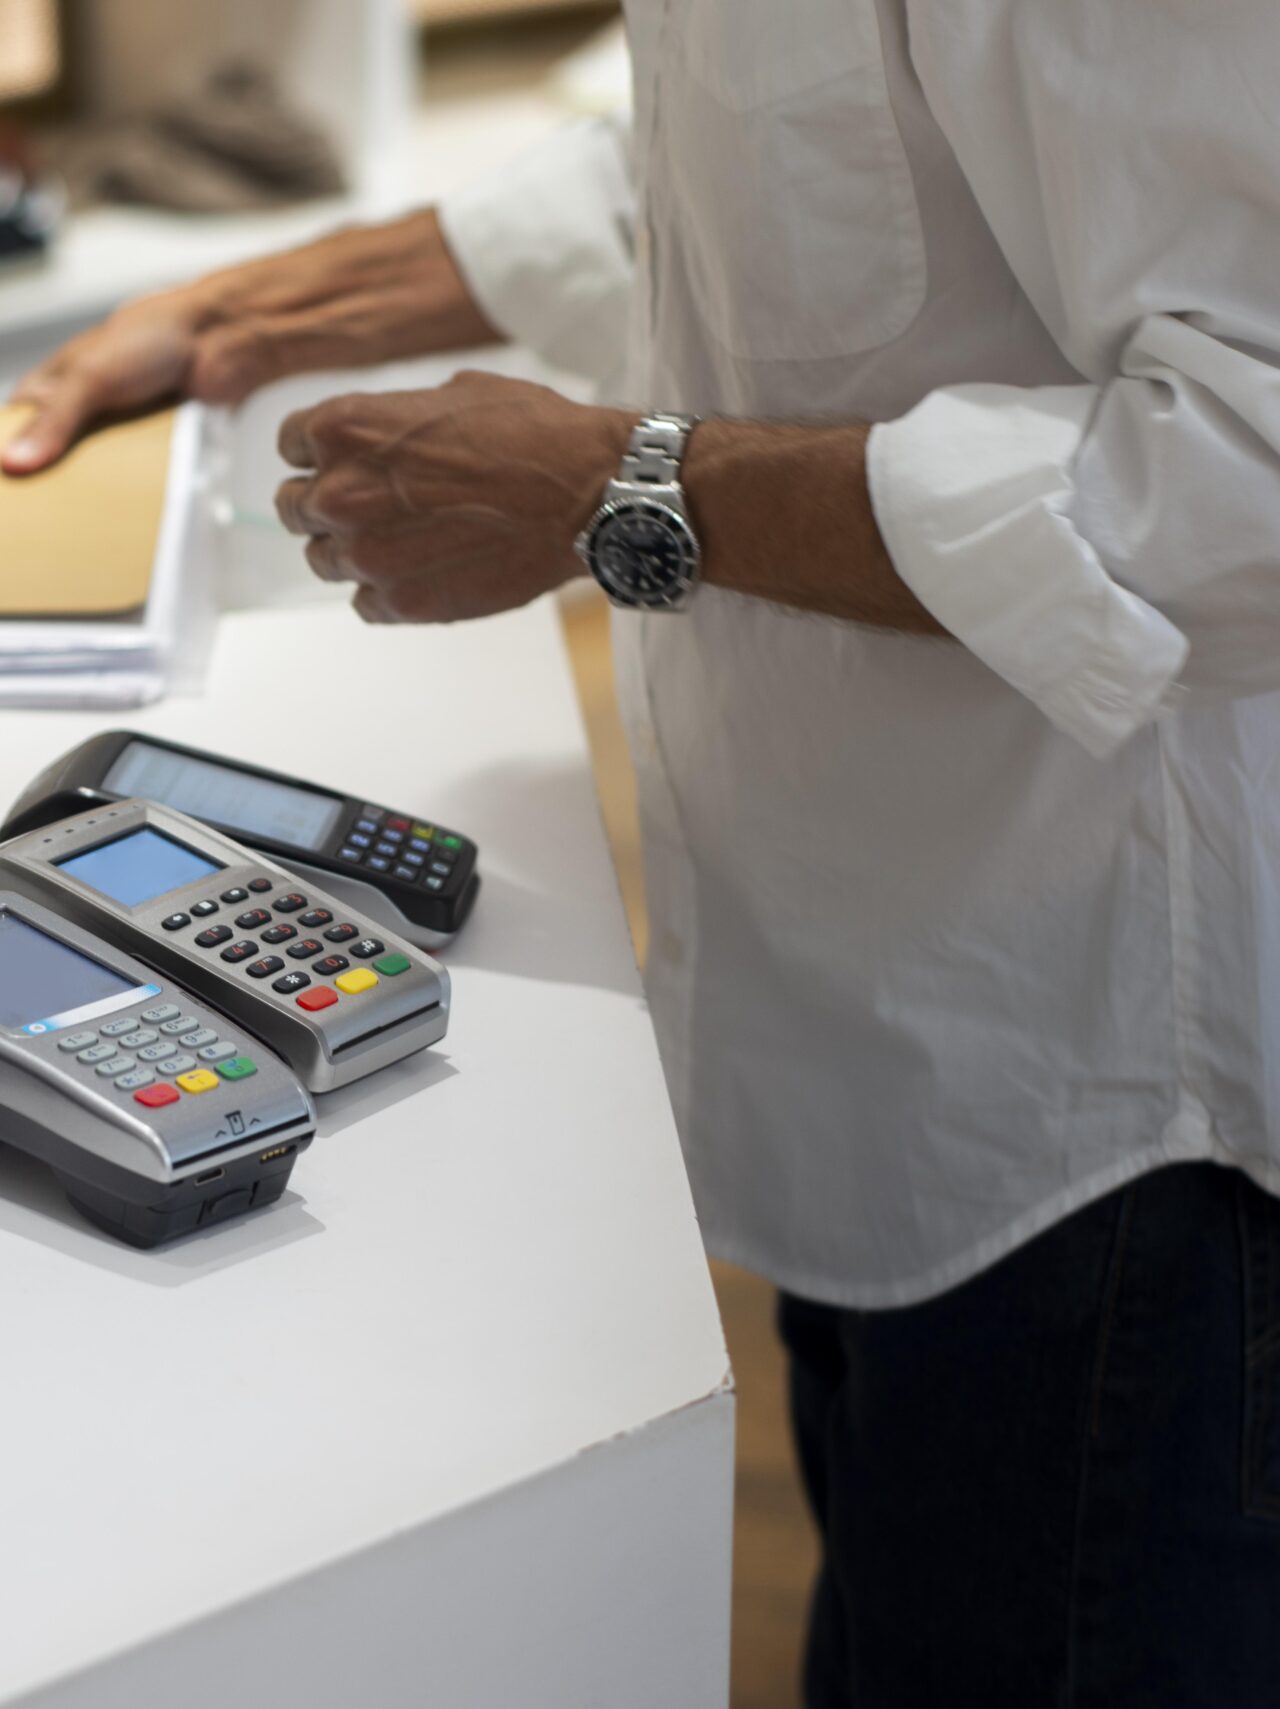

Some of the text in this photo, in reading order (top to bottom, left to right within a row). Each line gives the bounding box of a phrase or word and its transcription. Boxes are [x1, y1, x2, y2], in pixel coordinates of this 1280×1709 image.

[287, 894, 302, 904] 3
[251, 910, 266, 921] 2
[315, 909, 328, 919] 6
[278, 924, 291, 935] 5
[340, 924, 353, 933] 9
[206, 930, 218, 938] 1
[303, 940, 317, 950] 8
[232, 946, 245, 955] 4
[256, 960, 268, 970] 7
[106, 1024, 120, 1032] 2
[166, 1022, 178, 1030] 6
[126, 1036, 138, 1044] 5
[185, 1035, 197, 1043] 9
[88, 1049, 98, 1057] 4
[144, 1048, 156, 1057] 8
[164, 1062, 176, 1070] 0
